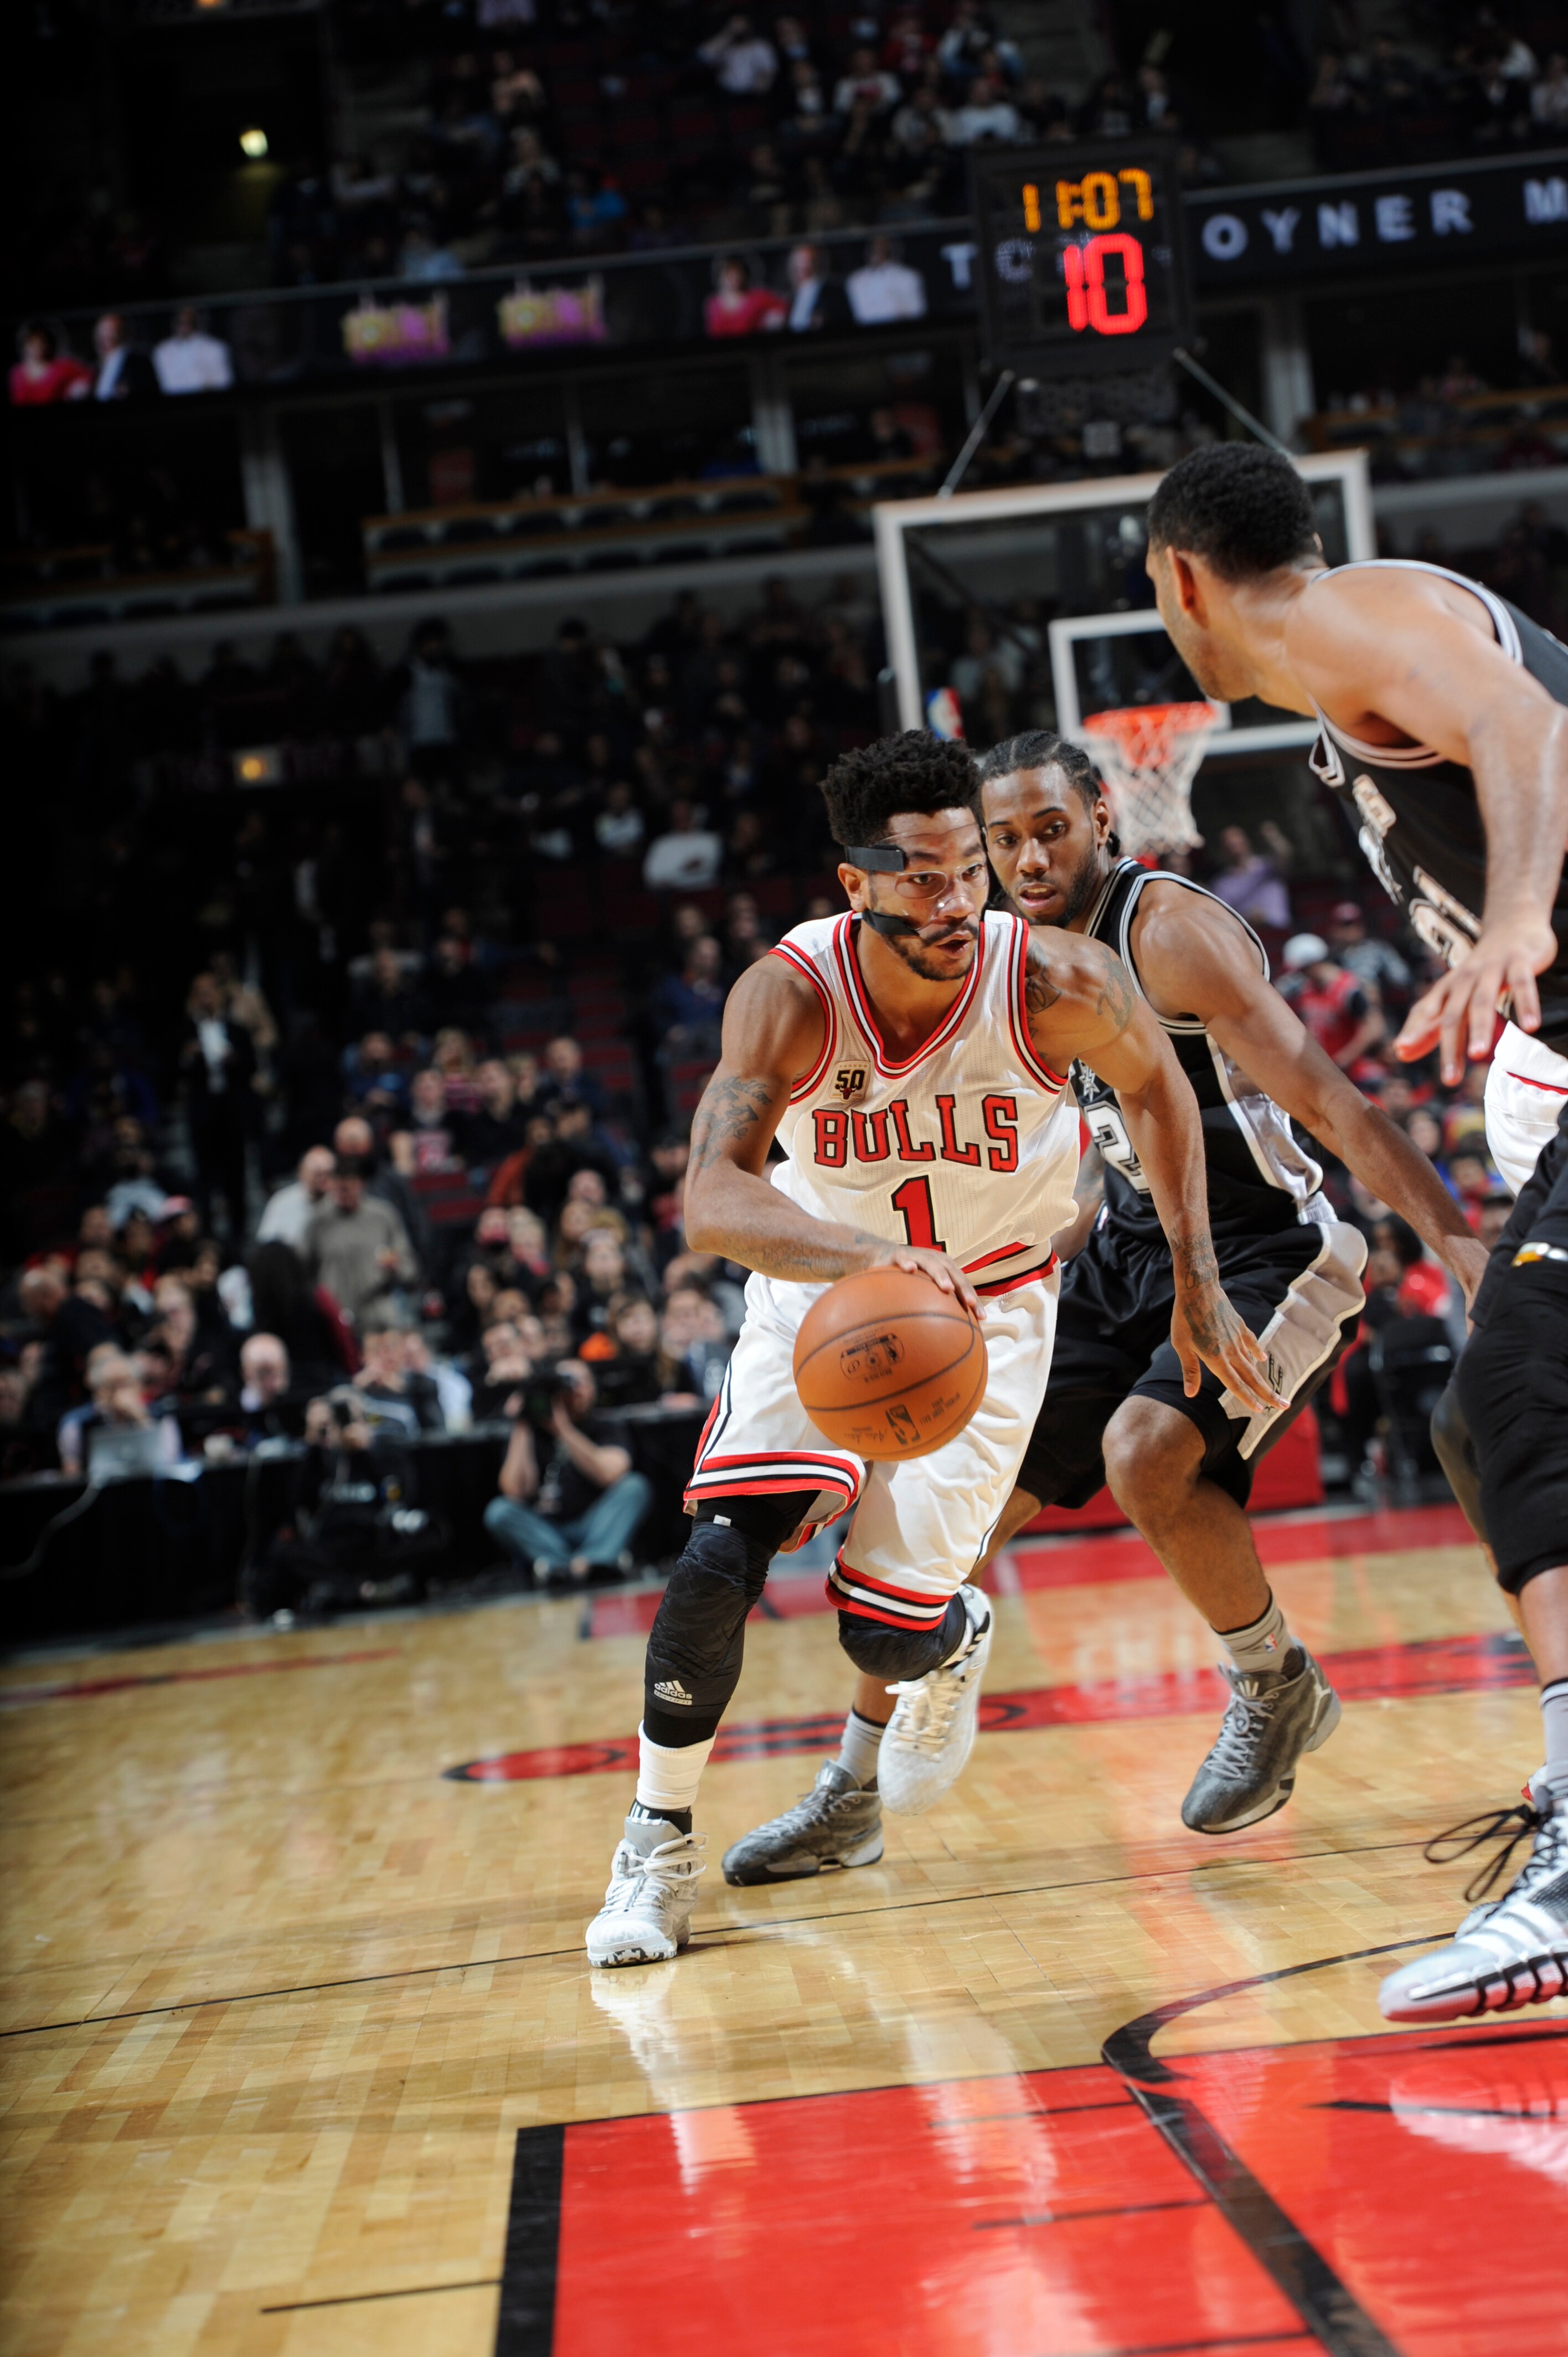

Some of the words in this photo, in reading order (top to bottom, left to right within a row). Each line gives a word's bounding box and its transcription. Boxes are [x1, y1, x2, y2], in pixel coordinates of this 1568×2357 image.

[1022, 168, 1153, 233] 11:07
[1063, 233, 1148, 336] 10
[835, 1069, 865, 1090] 50
[812, 1094, 1019, 1172] BULLS
[1084, 1100, 1152, 1195] 2
[891, 1175, 947, 1253] 1
[654, 1682, 692, 1700] adidas
